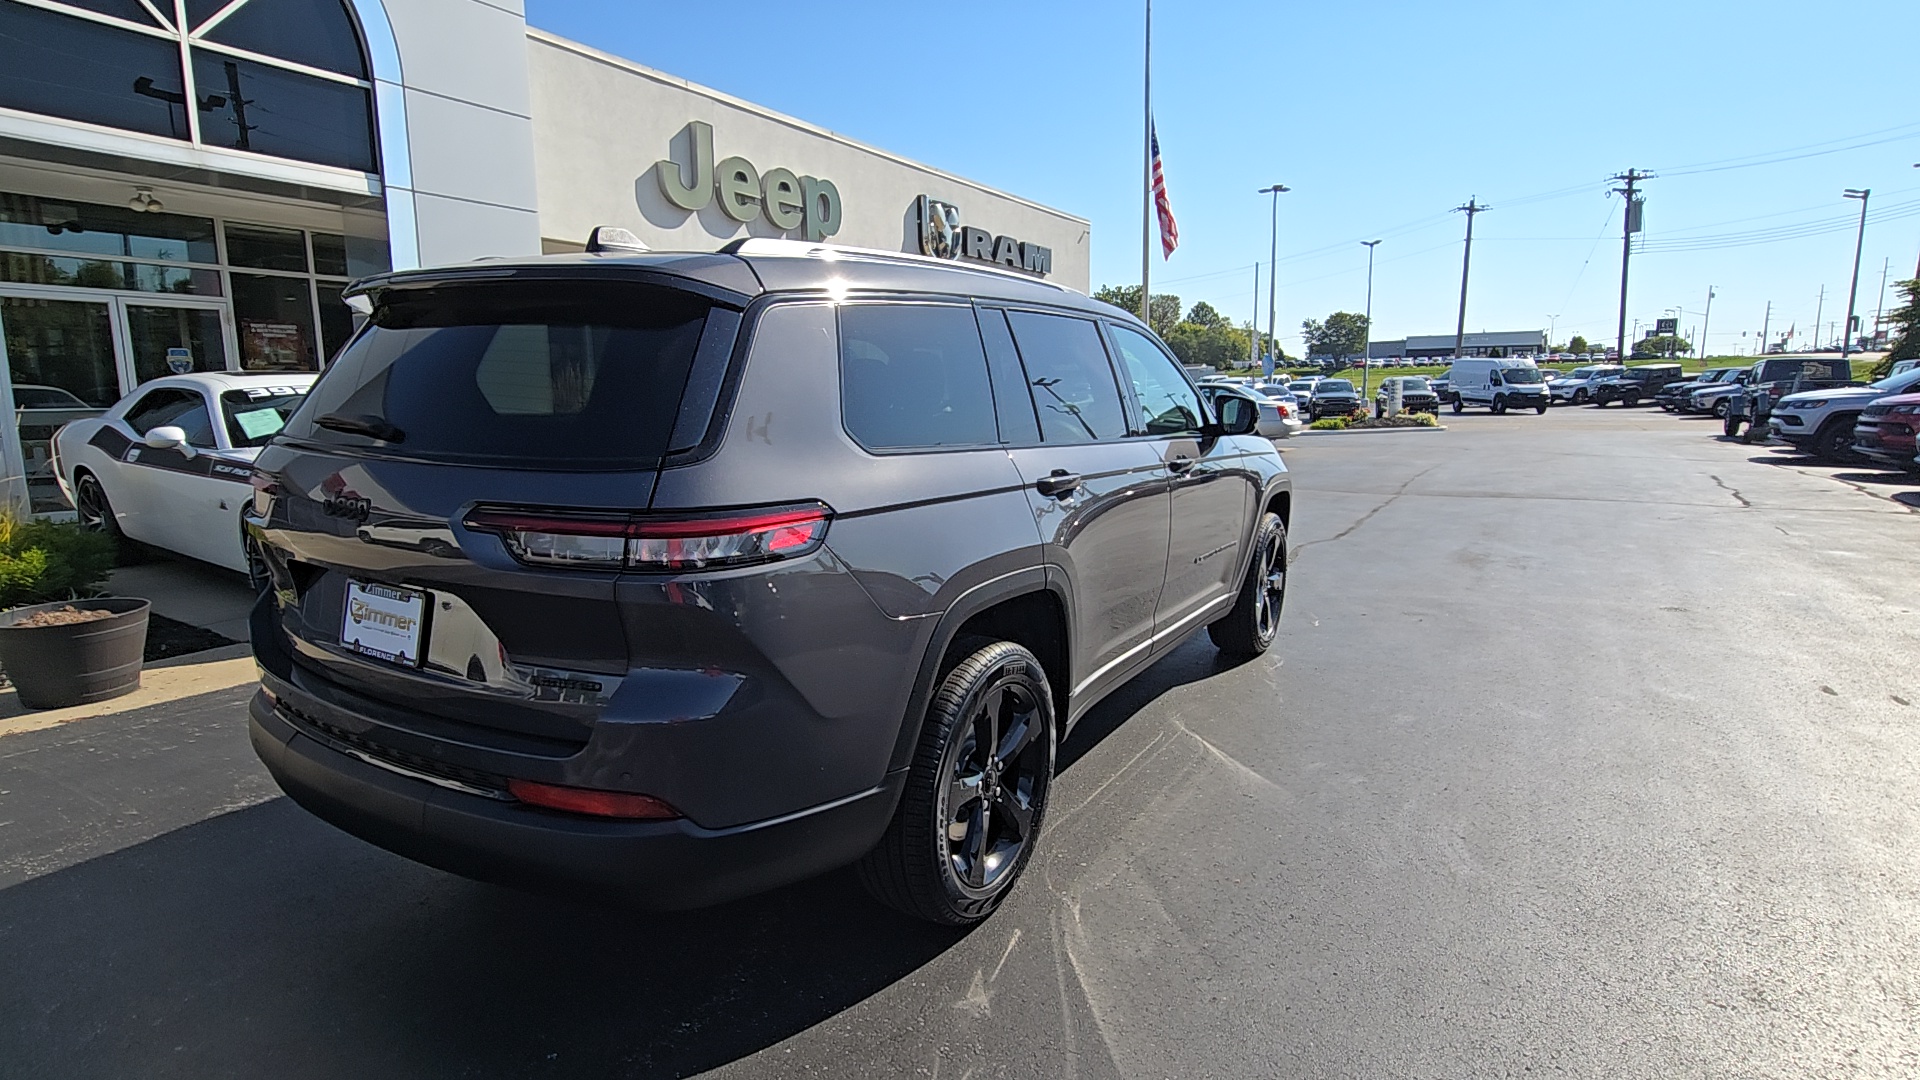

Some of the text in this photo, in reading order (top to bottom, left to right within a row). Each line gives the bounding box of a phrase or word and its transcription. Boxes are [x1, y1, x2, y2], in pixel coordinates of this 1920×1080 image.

[656, 120, 842, 242] Jeep
[961, 225, 1052, 274] RAM
[365, 583, 402, 600] Zimmer
[352, 599, 417, 632] Zimmer
[359, 646, 396, 662] FLORENCE
